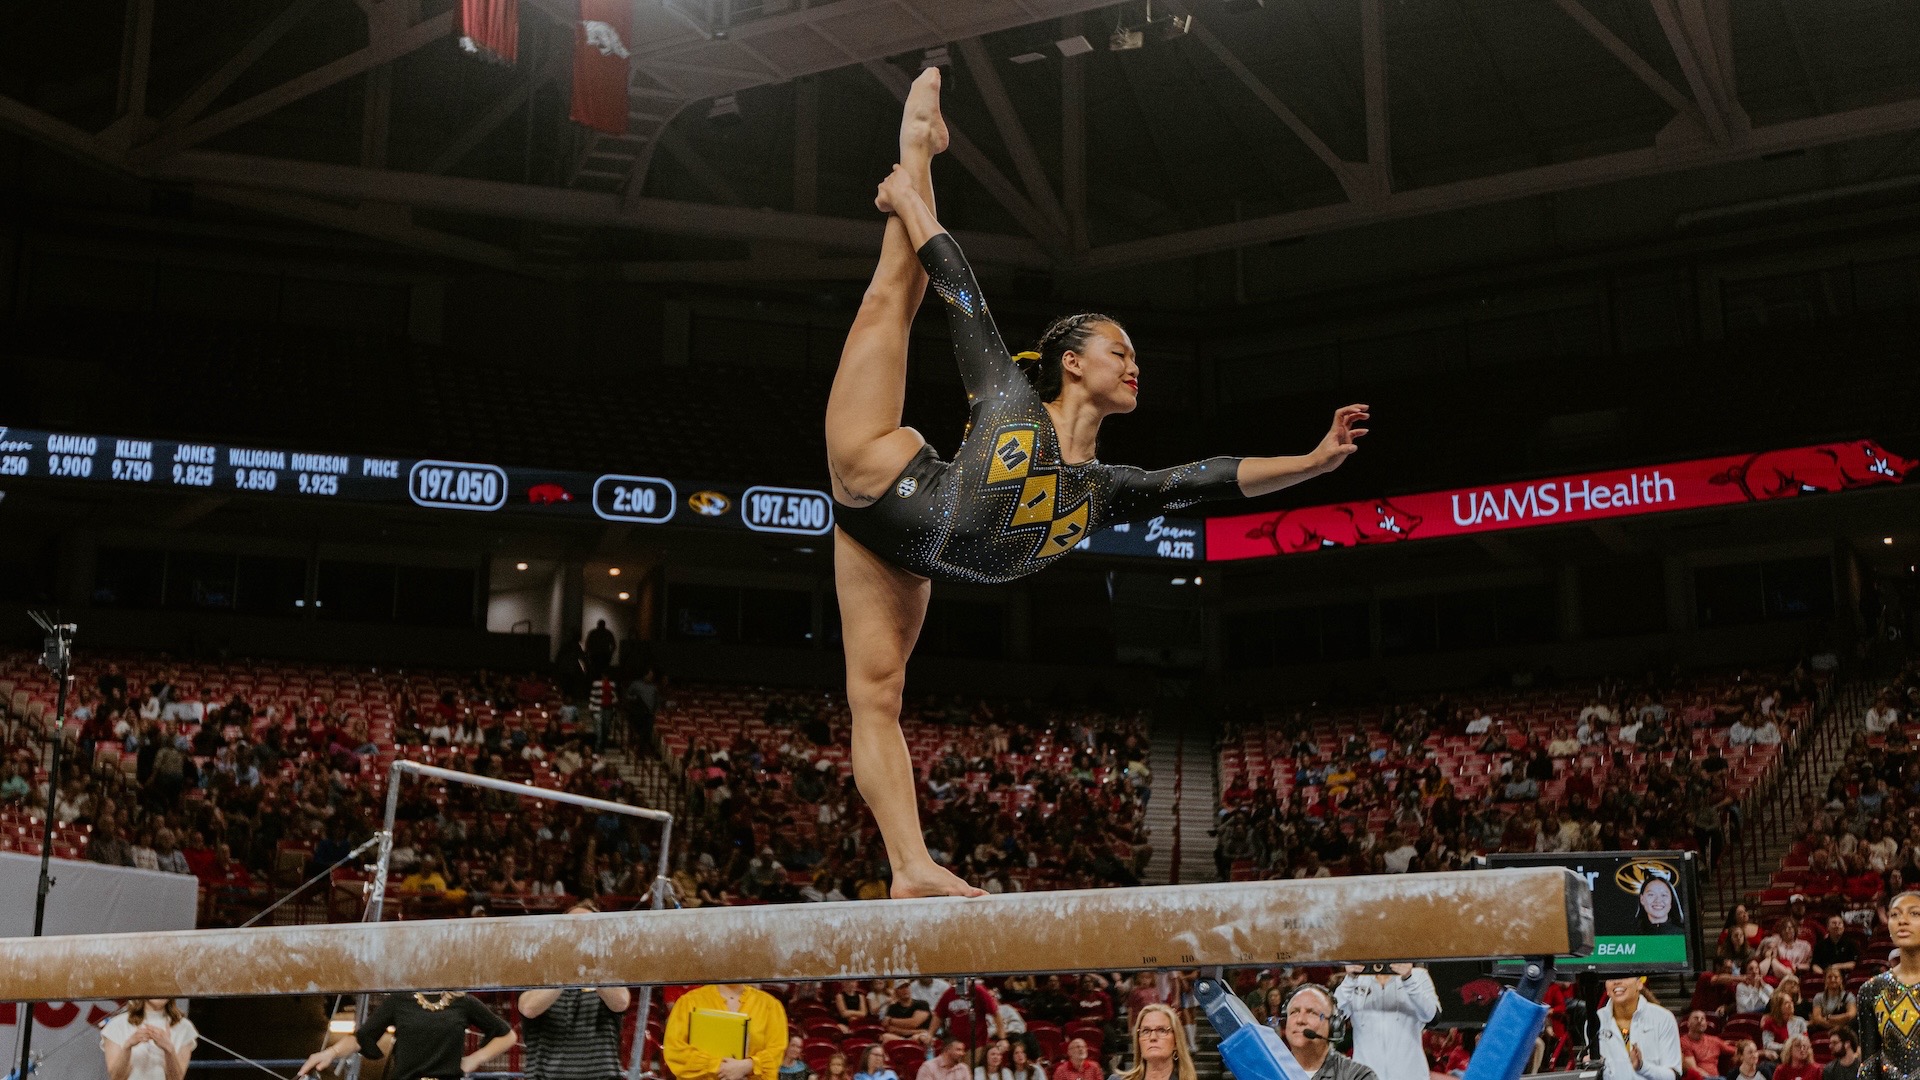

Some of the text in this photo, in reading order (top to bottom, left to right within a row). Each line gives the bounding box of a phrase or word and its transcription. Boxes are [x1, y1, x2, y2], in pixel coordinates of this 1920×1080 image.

[115, 440, 152, 460] KLEIN
[173, 444, 216, 465] JONES
[229, 448, 285, 470] WALIGORA
[291, 453, 349, 475] ROBERSON
[363, 458, 399, 479] PRICE
[49, 454, 92, 477] 9.900
[111, 459, 153, 482] 9.750
[173, 463, 214, 486] 9.825
[235, 468, 277, 491] 9.850
[299, 473, 338, 496] 9.925
[418, 467, 497, 504] 197.050
[613, 486, 656, 514] 2:00
[750, 494, 824, 528] 197.500
[1145, 515, 1196, 542] Beam
[1157, 540, 1194, 559] 49.275
[1142, 956, 1157, 964] 100
[1181, 954, 1195, 963] 110
[1276, 951, 1291, 960] 125
[1597, 943, 1637, 955] BEAM
